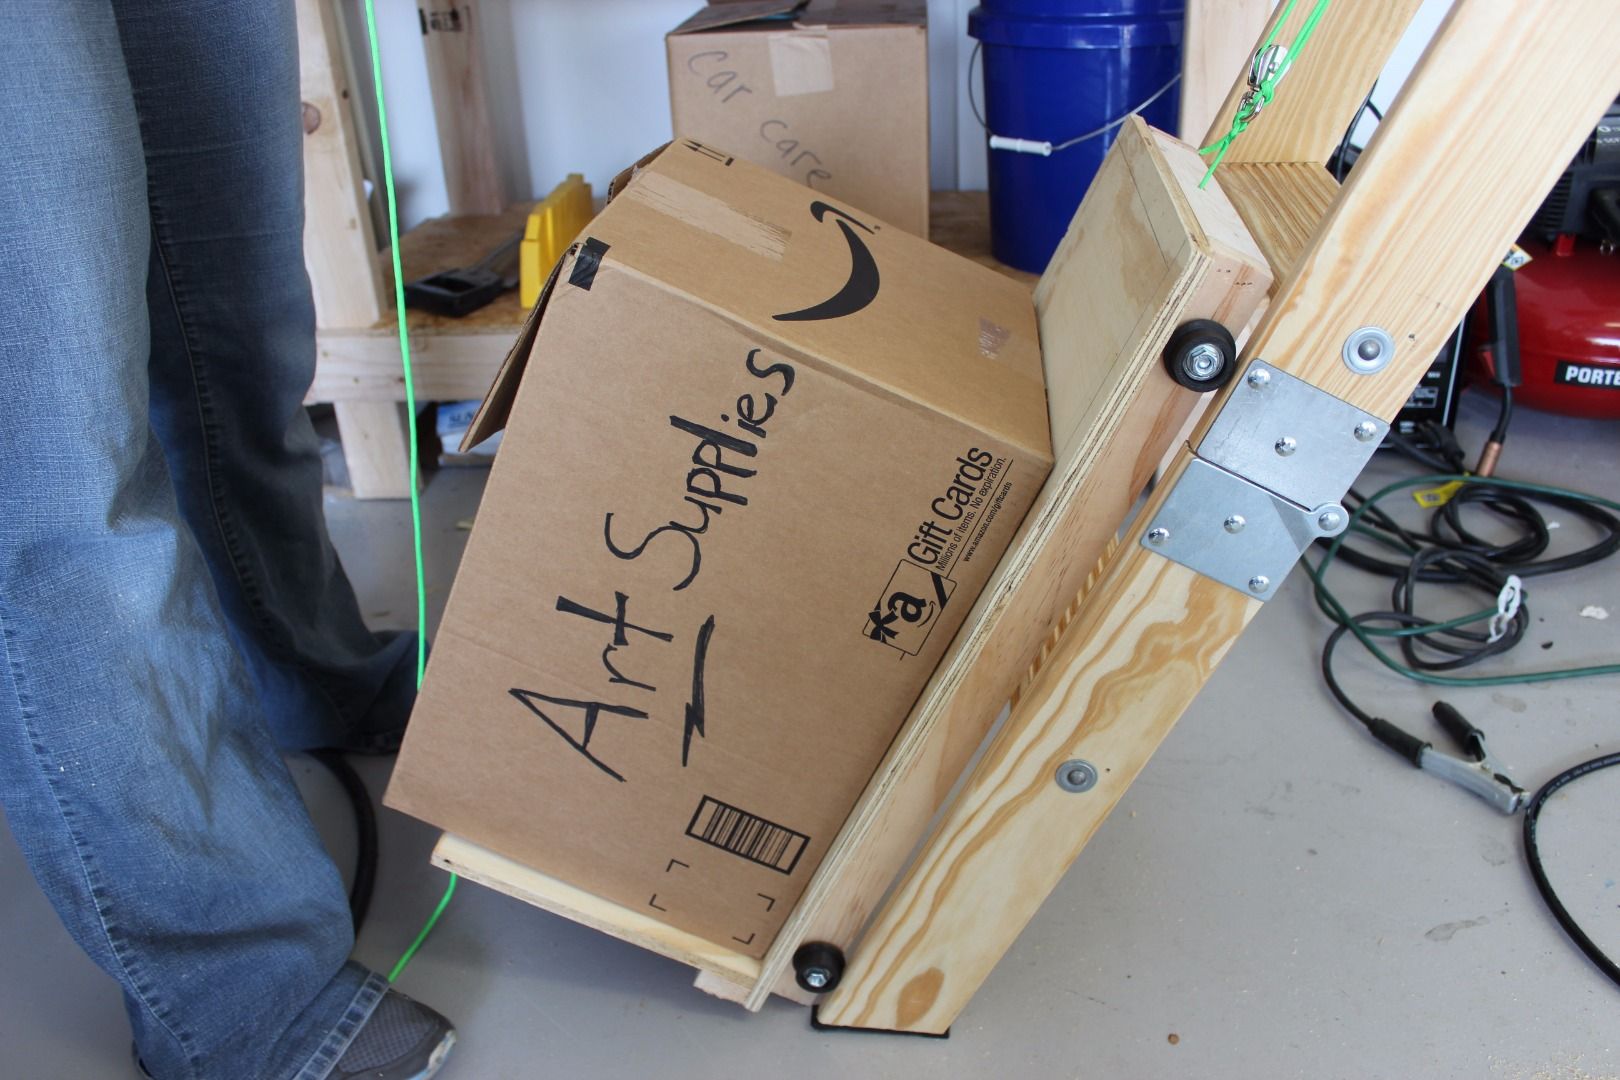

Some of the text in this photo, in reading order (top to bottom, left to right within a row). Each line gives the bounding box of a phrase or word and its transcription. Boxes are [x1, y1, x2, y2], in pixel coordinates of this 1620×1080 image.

[688, 51, 832, 189] Car Care
[508, 348, 796, 782] Art Supplies
[907, 447, 993, 565] Gift Cards
[936, 457, 1007, 571] Millions of items. No expiration.
[963, 481, 1013, 562] www.amazon.com/giftcards
